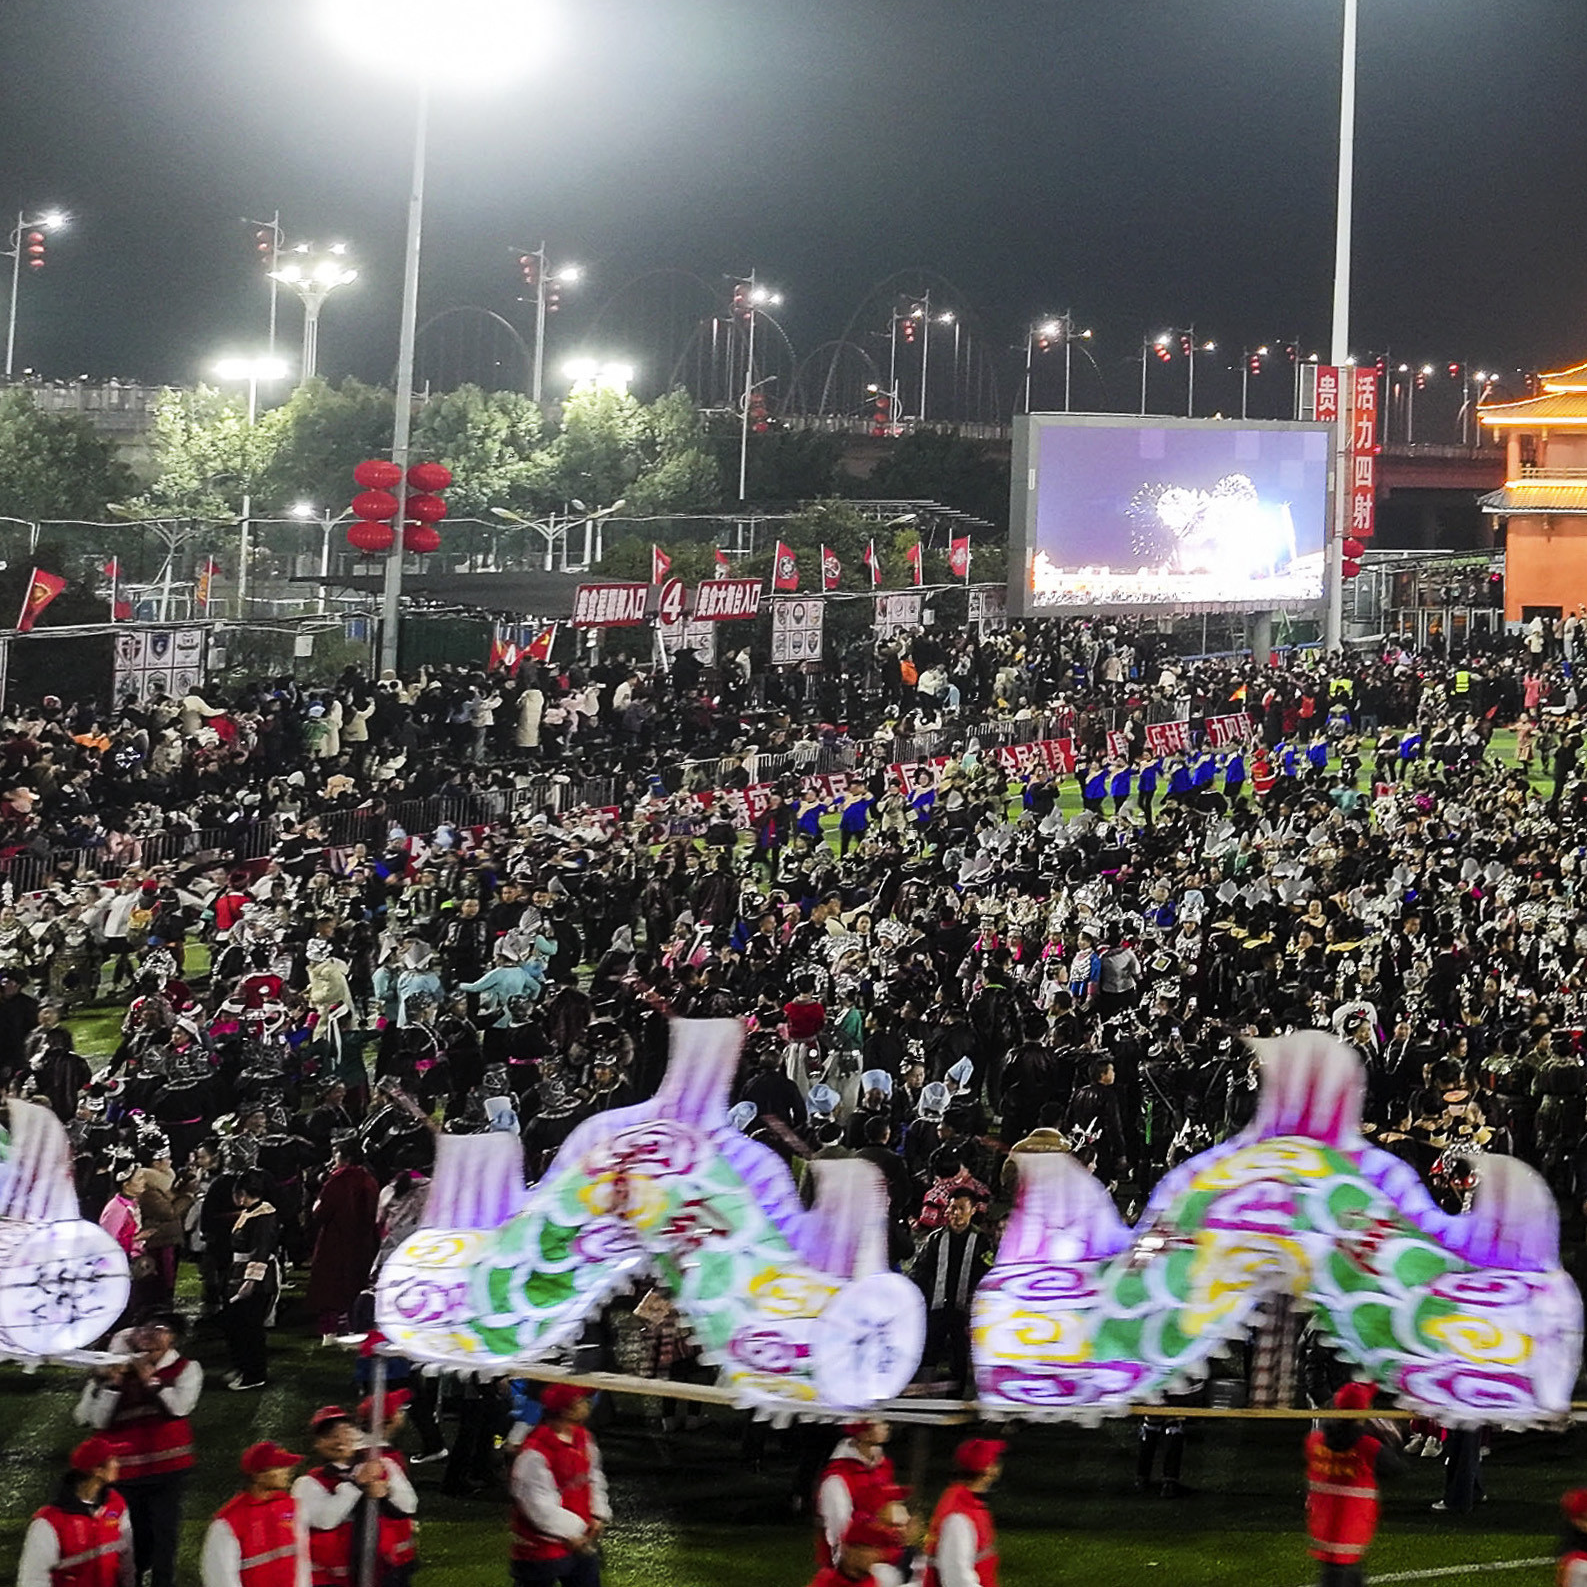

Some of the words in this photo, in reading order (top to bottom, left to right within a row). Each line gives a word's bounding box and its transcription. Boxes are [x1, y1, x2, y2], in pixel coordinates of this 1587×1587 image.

[1353, 376, 1375, 529] 活力四射
[663, 582, 683, 621] 4
